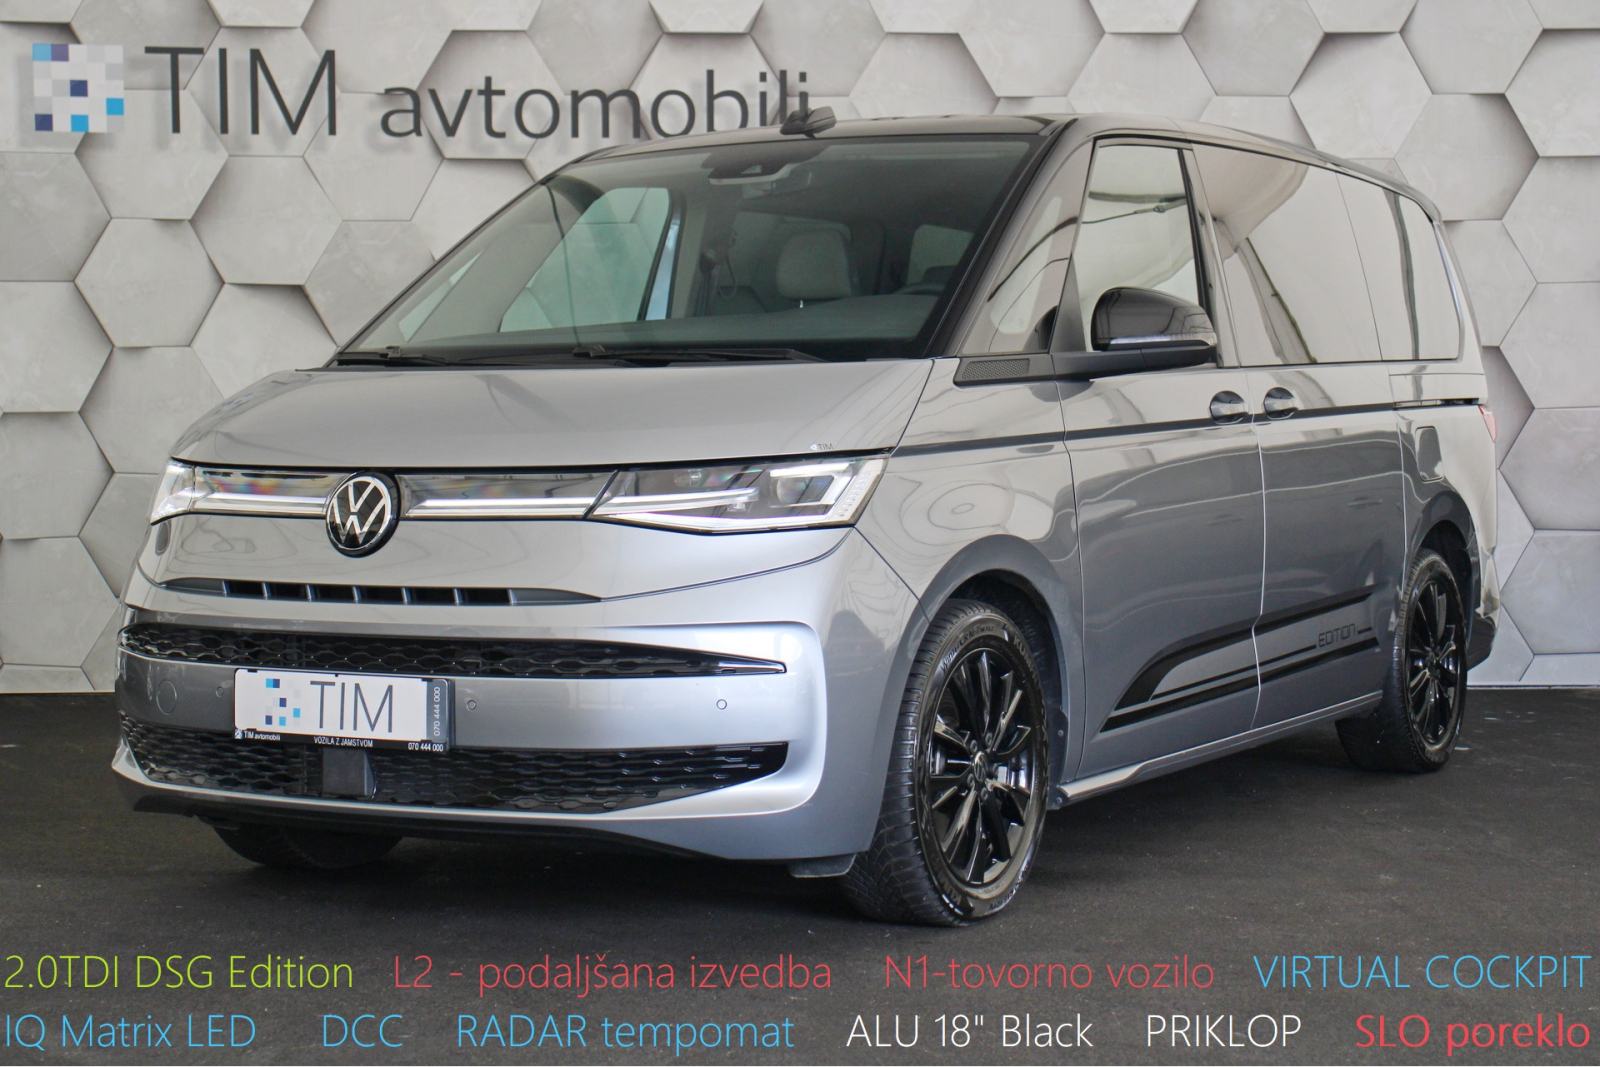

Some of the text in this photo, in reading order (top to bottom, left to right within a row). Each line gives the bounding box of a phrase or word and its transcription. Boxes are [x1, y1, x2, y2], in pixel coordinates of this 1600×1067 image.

[144, 46, 336, 135] TIM
[310, 680, 394, 733] TIM
[433, 686, 441, 737] 070 444 000
[243, 730, 281, 741] TIM avtomobili
[313, 736, 374, 747] VOZILA Z JAMSTVOM
[407, 741, 444, 752] 070 444 000
